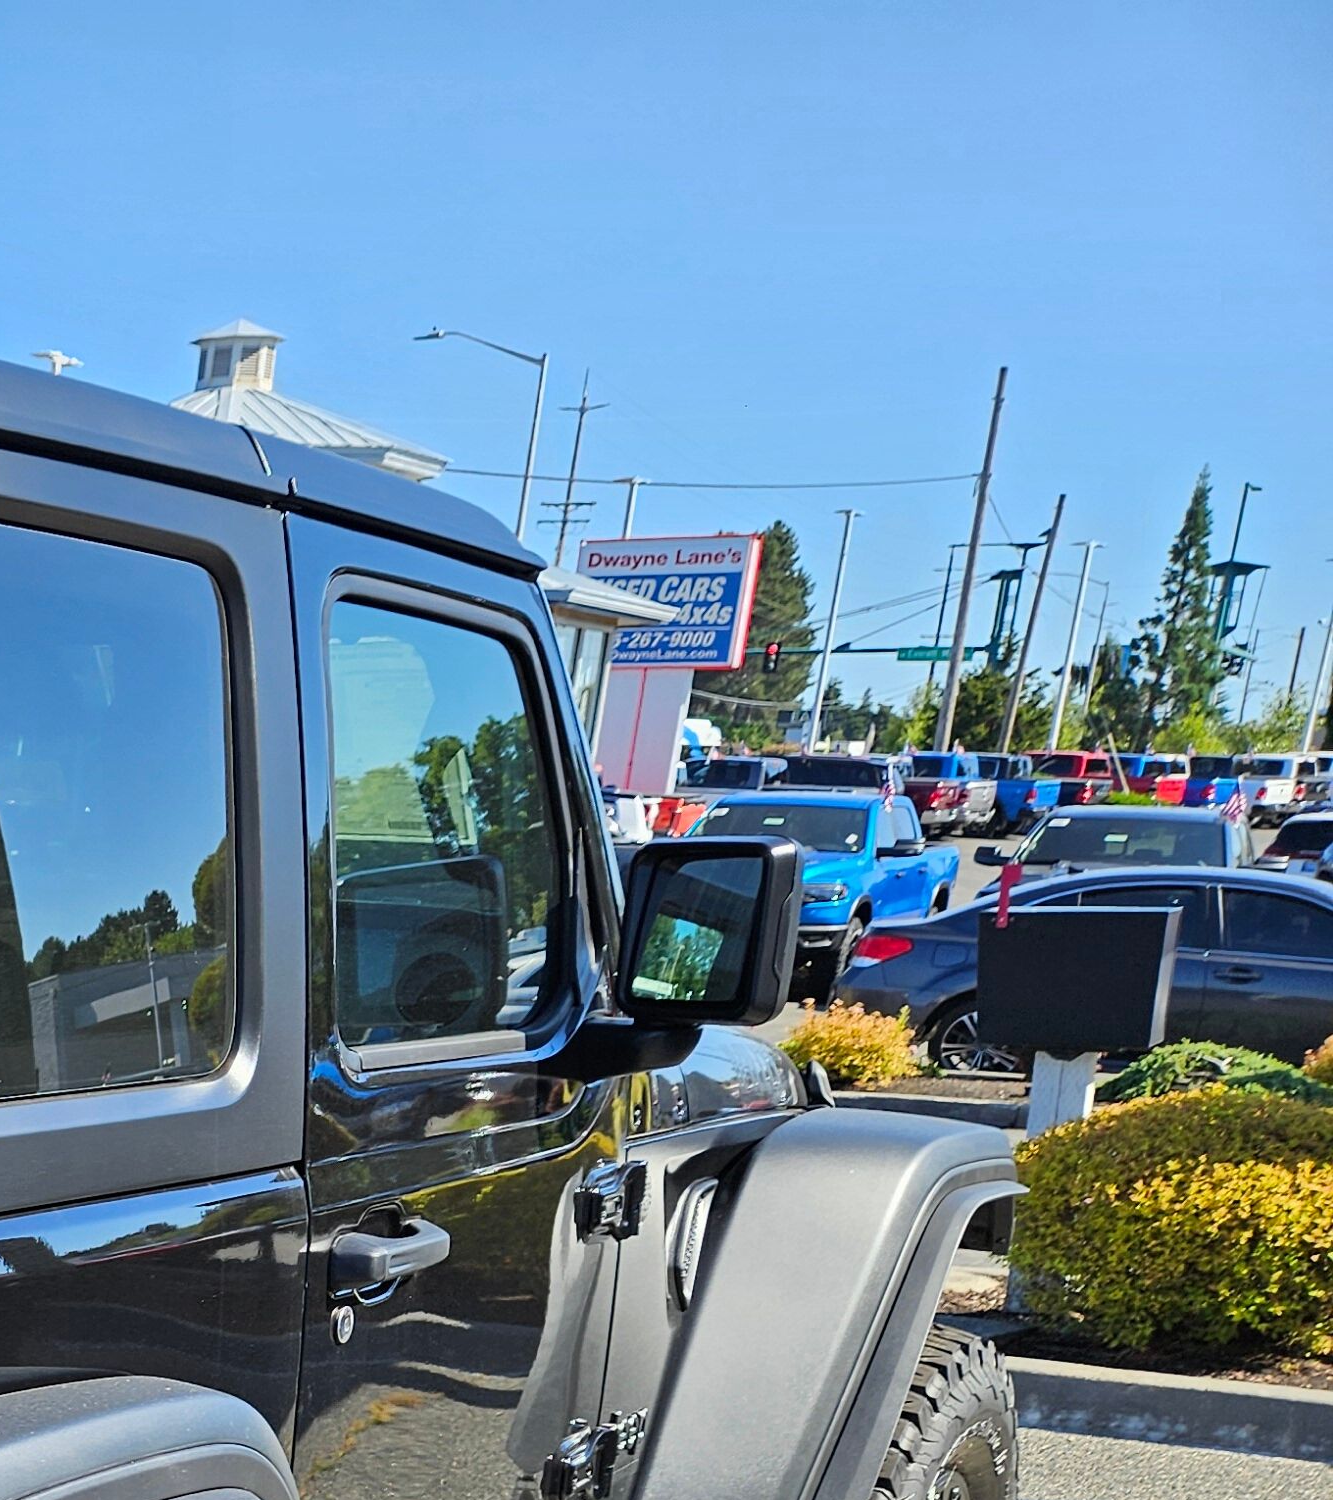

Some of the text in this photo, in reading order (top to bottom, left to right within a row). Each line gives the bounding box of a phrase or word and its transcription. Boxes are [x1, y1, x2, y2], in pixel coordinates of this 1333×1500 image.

[587, 548, 742, 570] Dwayne Lane's
[657, 575, 727, 604] CARS
[673, 602, 734, 626] 4x4s
